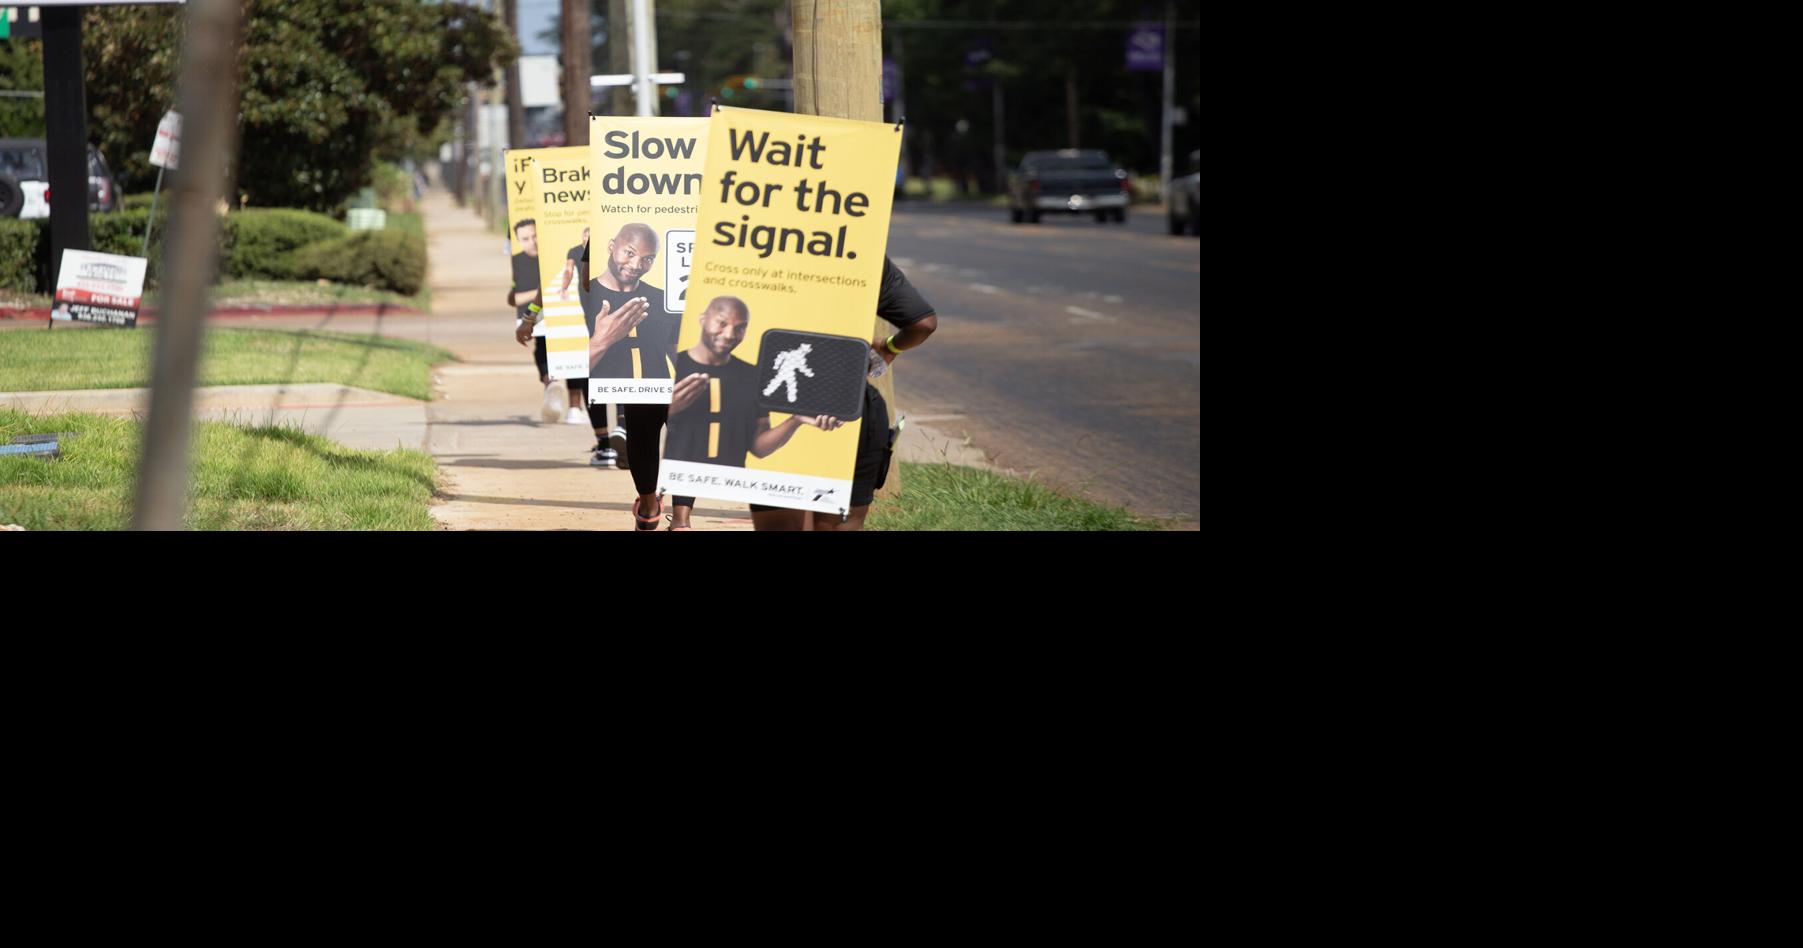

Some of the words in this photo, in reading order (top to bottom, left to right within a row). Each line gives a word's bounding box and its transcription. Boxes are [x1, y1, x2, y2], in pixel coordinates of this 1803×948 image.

[604, 130, 697, 159] Slow
[729, 128, 826, 170] Wait
[543, 166, 590, 183] Brak
[602, 166, 703, 195] down
[720, 171, 782, 207] for
[794, 178, 869, 217] the
[601, 205, 633, 214] Watch
[636, 205, 651, 214] for
[654, 205, 698, 215] pedestri
[712, 215, 857, 260] signal.
[703, 275, 726, 286] and
[728, 277, 797, 294] crosswalks.
[705, 261, 739, 275] Cross
[742, 265, 768, 279] only
[771, 268, 785, 279] at
[787, 268, 867, 288] intersections
[70, 304, 90, 313] JEFF
[91, 293, 111, 304] FOR
[111, 296, 134, 307] SALE
[669, 472, 684, 482] BE
[688, 473, 721, 486] SAFE.
[724, 478, 758, 490] WALK
[761, 482, 804, 495] SMART.
